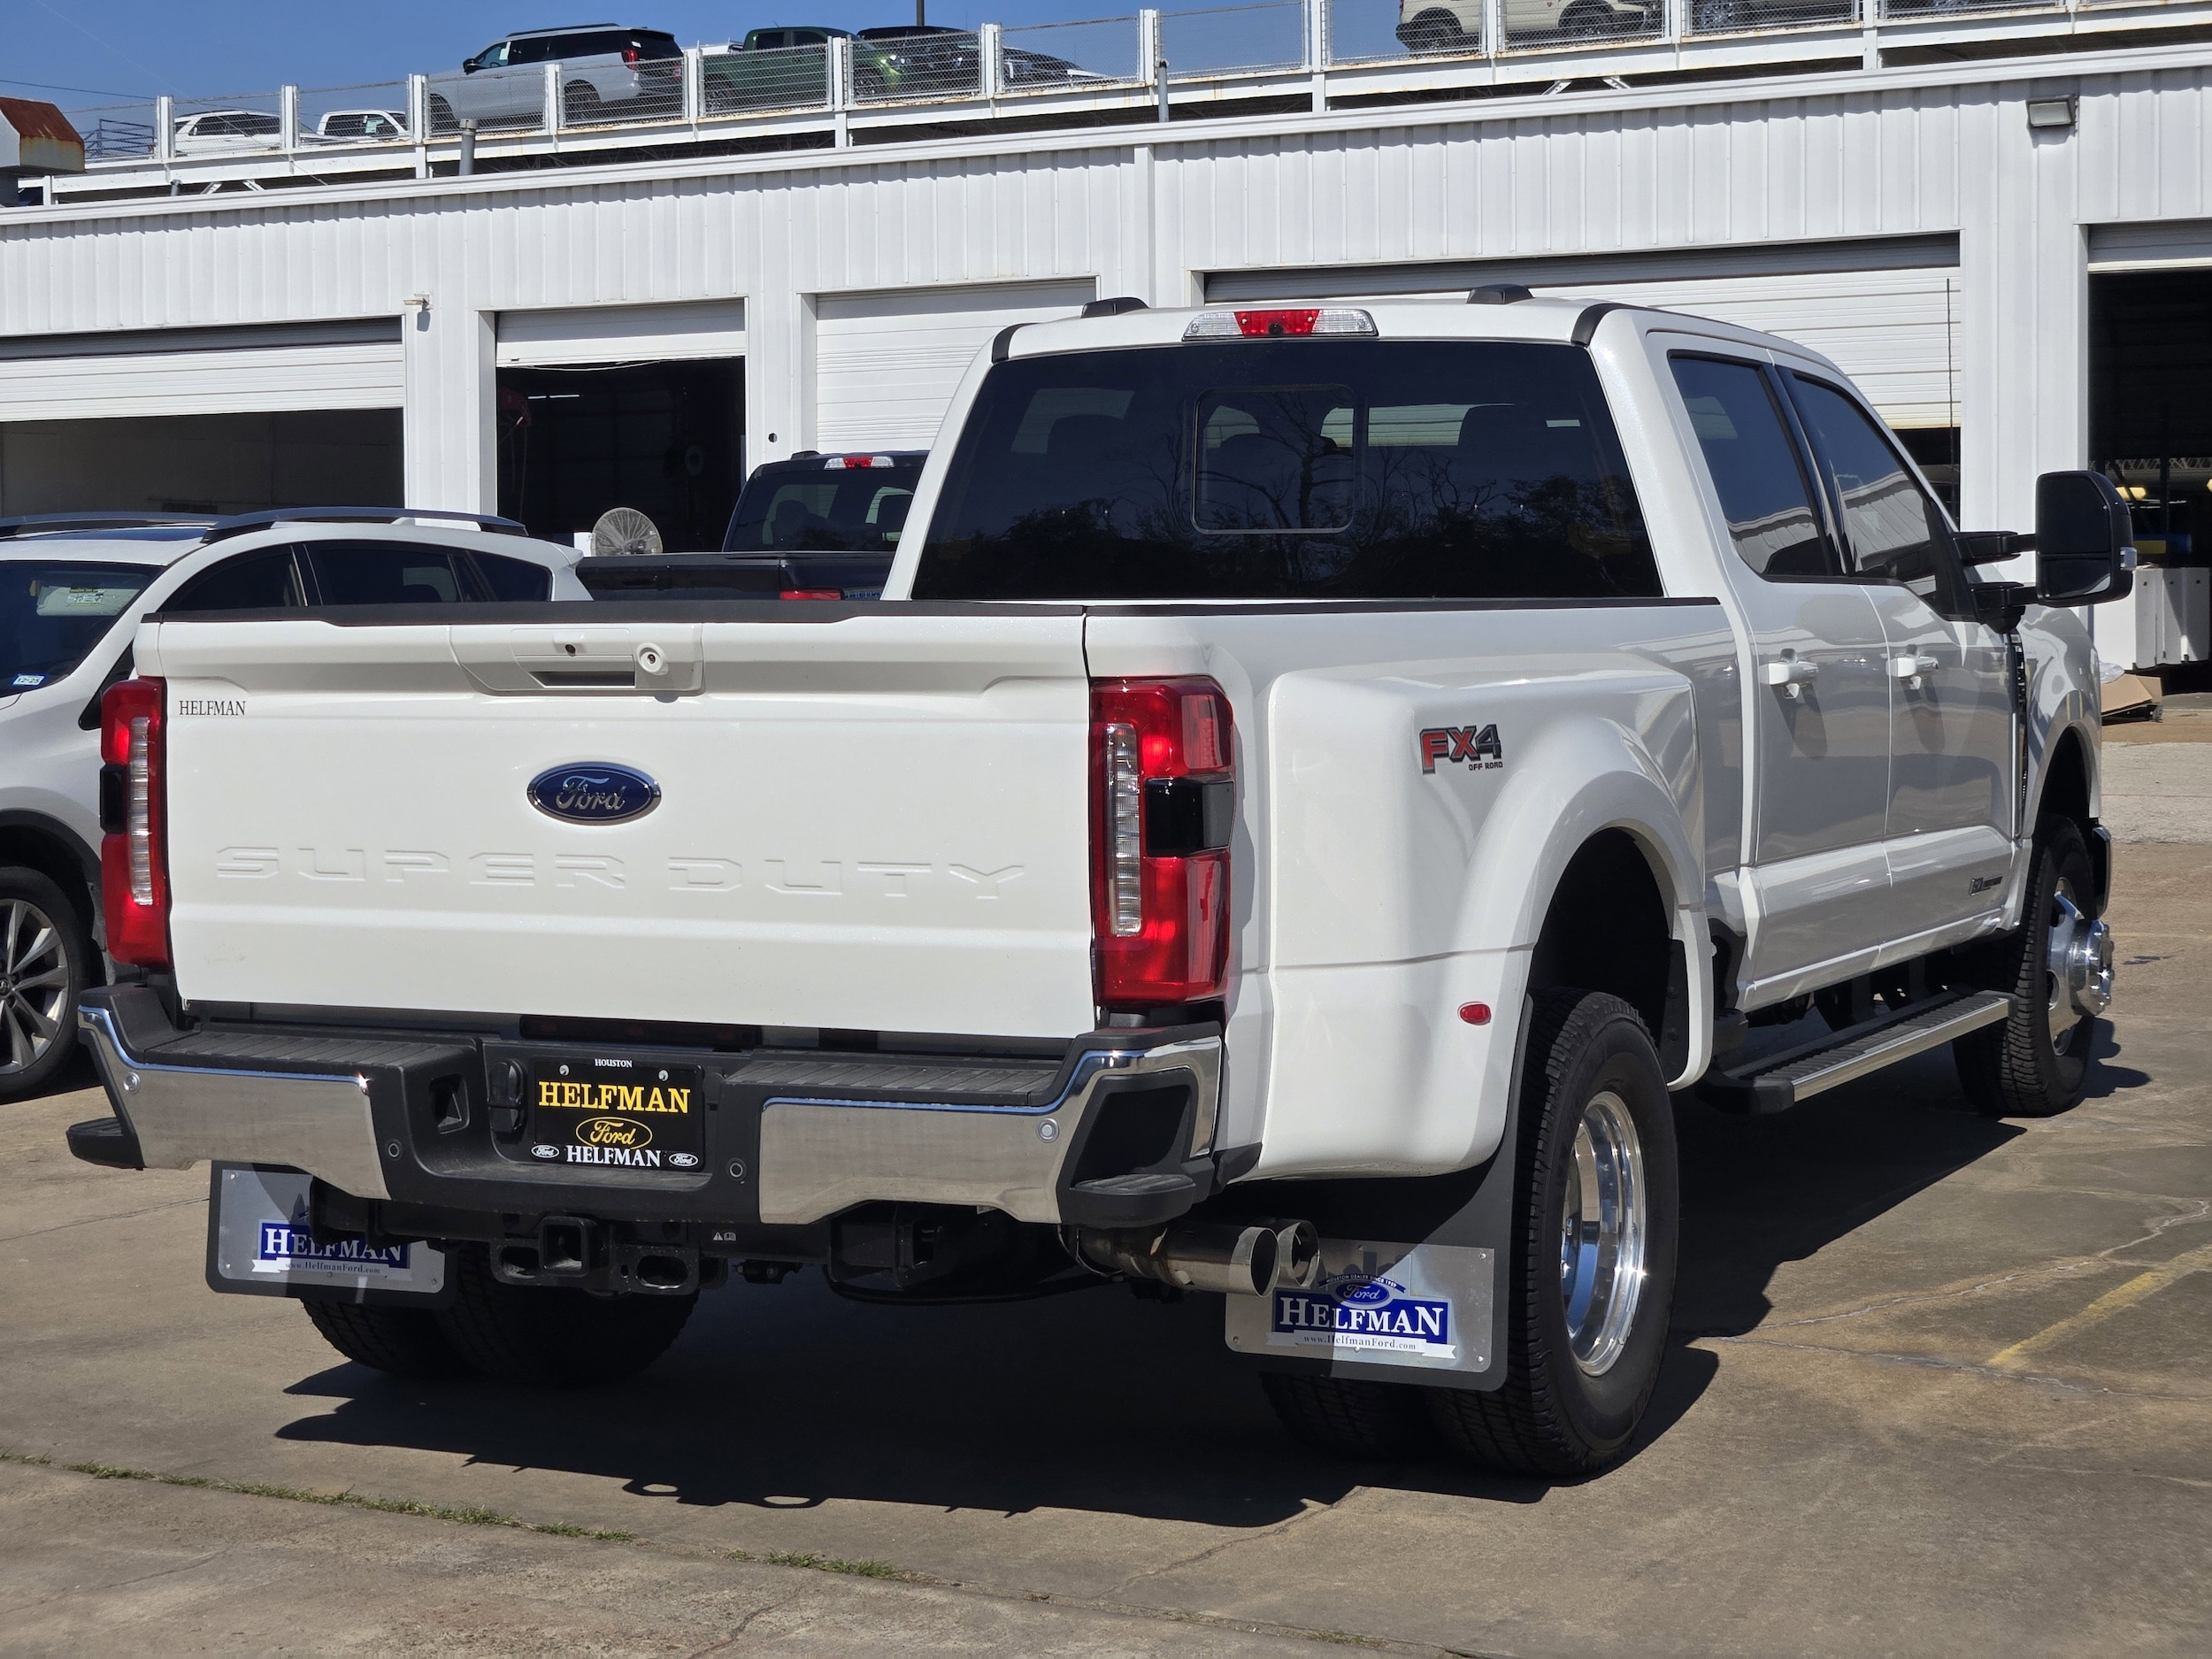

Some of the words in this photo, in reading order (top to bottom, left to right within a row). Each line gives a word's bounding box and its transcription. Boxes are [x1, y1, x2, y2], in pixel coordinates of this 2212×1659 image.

[179, 700, 247, 716] HELFMAN
[1419, 724, 1502, 775] FX4
[1485, 761, 1503, 770] ROAD
[556, 775, 627, 810] Ford
[217, 846, 626, 889] SUPER
[667, 856, 1025, 900] DUTY
[595, 1058, 633, 1068] HOUSTON
[538, 1081, 691, 1114] HELFMAN
[590, 1120, 636, 1145] Ford
[565, 1145, 661, 1167] HELFMAN
[285, 1262, 380, 1274] www.HelfmanFord.com
[1343, 1284, 1380, 1299] Ford
[1279, 1296, 1444, 1336] HELFMAN
[1303, 1333, 1417, 1350] www.HelfmanFord.com
